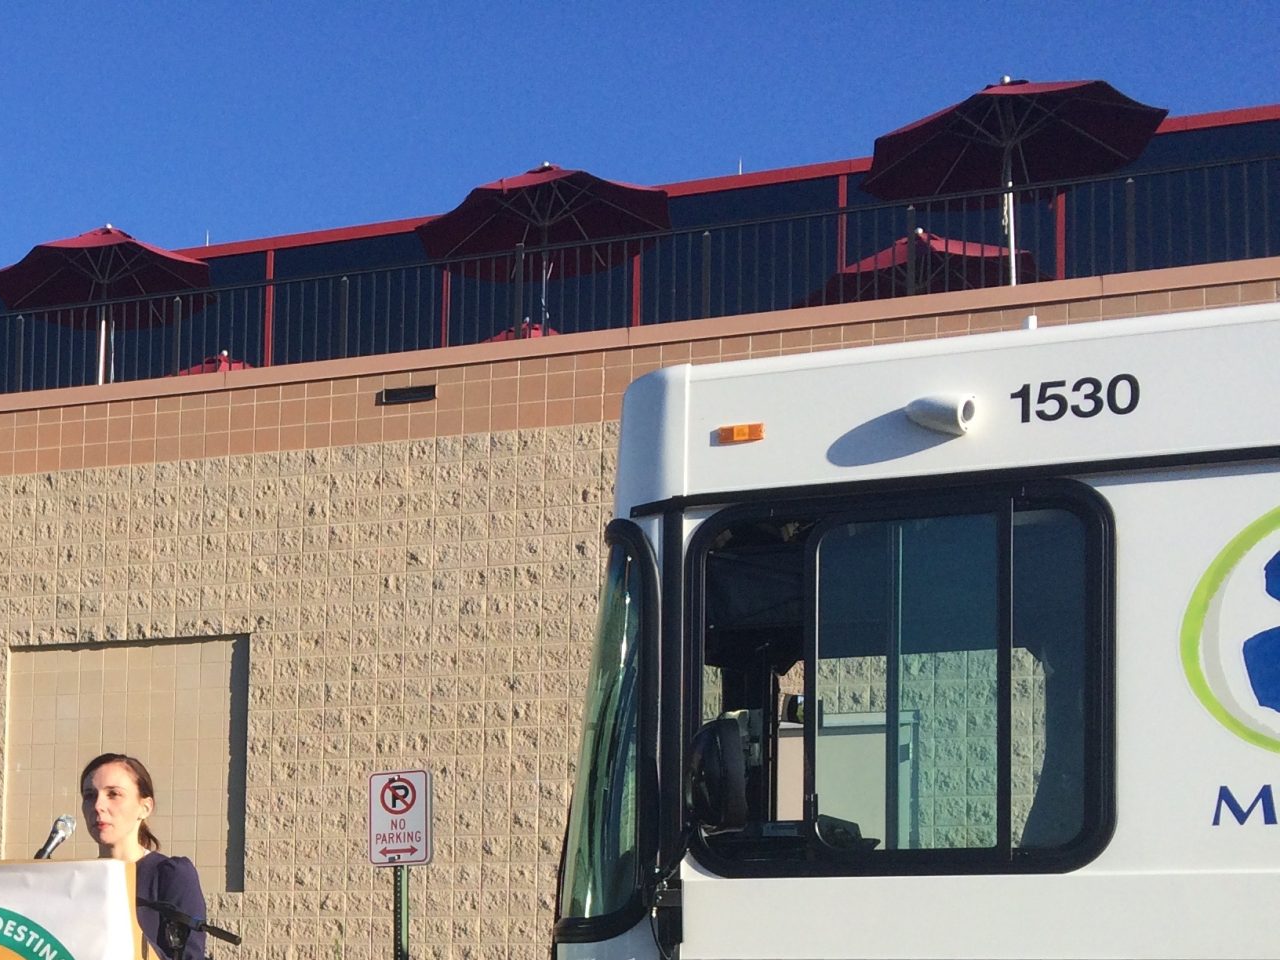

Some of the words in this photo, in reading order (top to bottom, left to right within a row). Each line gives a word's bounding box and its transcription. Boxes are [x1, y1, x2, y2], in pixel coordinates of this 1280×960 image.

[1010, 373, 1140, 423] 1530
[390, 818, 406, 831] NO
[375, 831, 422, 845] PARKING
